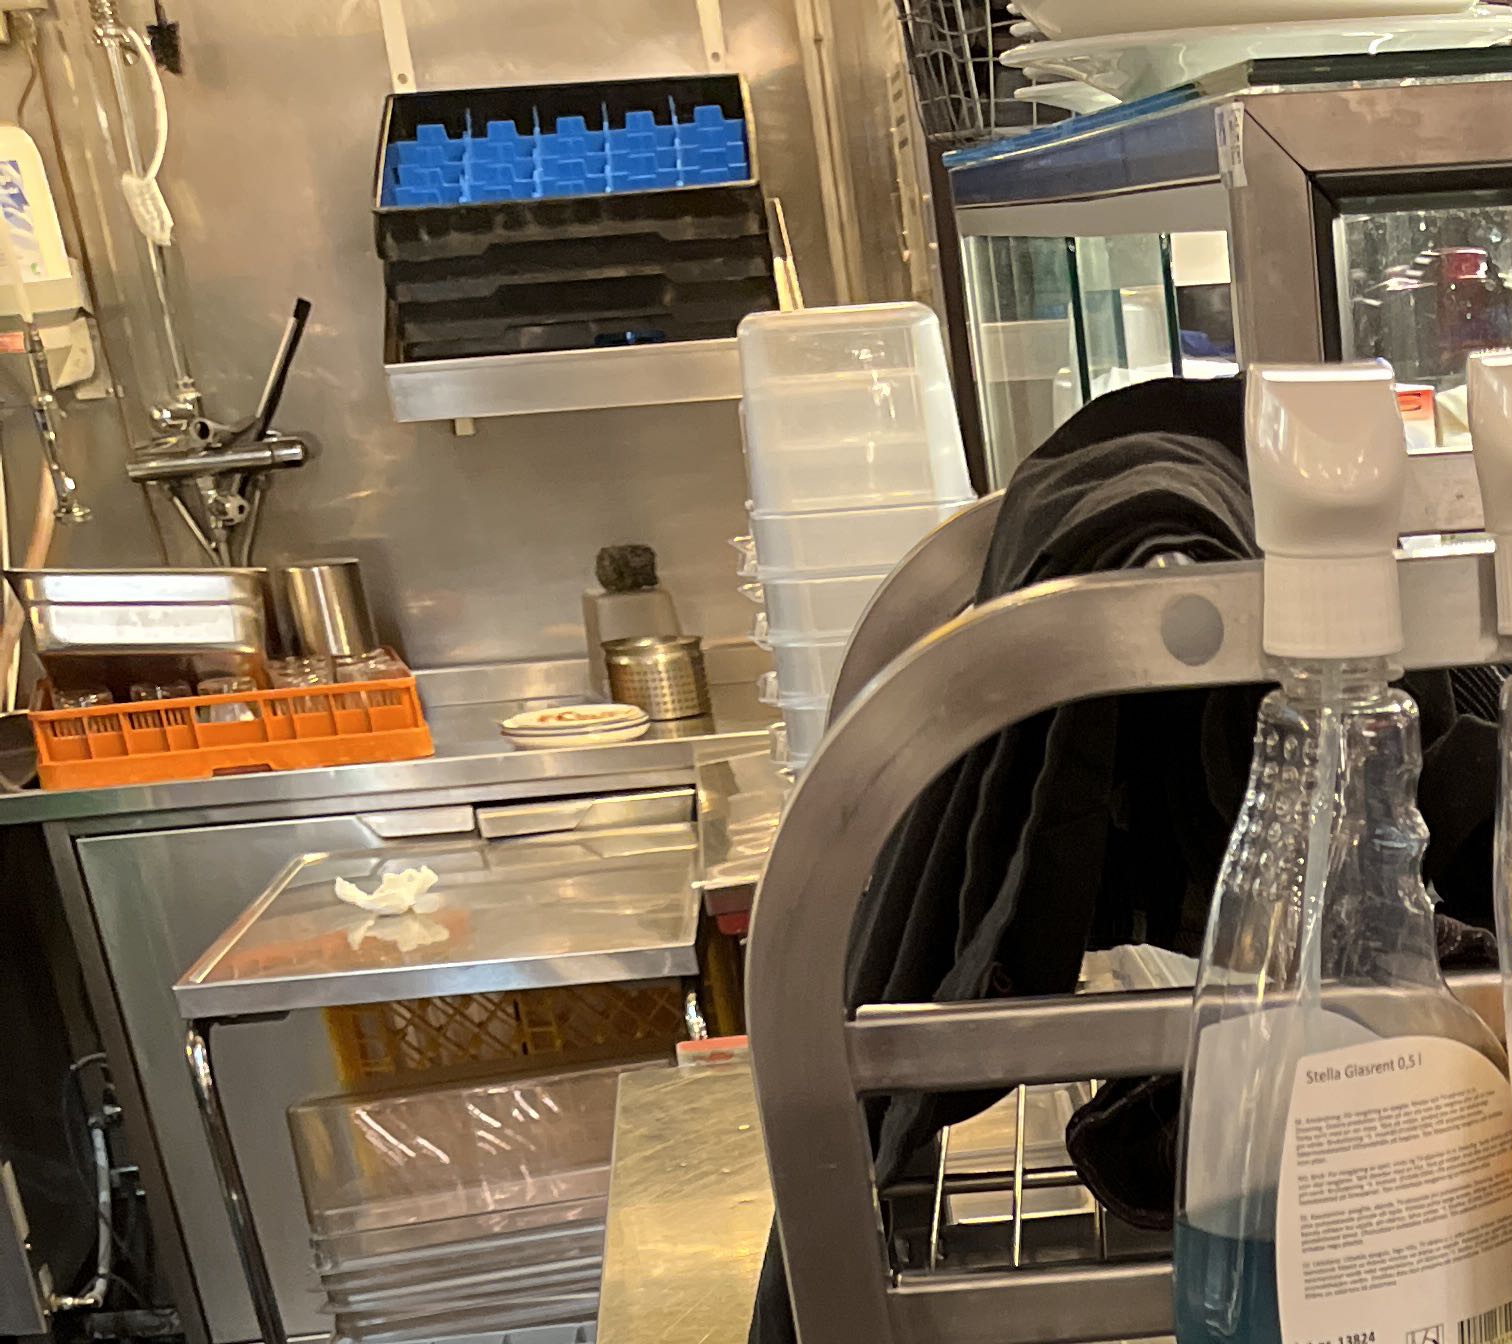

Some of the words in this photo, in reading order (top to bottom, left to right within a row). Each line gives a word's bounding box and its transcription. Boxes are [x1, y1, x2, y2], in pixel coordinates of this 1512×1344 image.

[1306, 1066, 1341, 1084] Stella
[1344, 1059, 1394, 1079] Glasrent
[1397, 1054, 1417, 1071] 0,5
